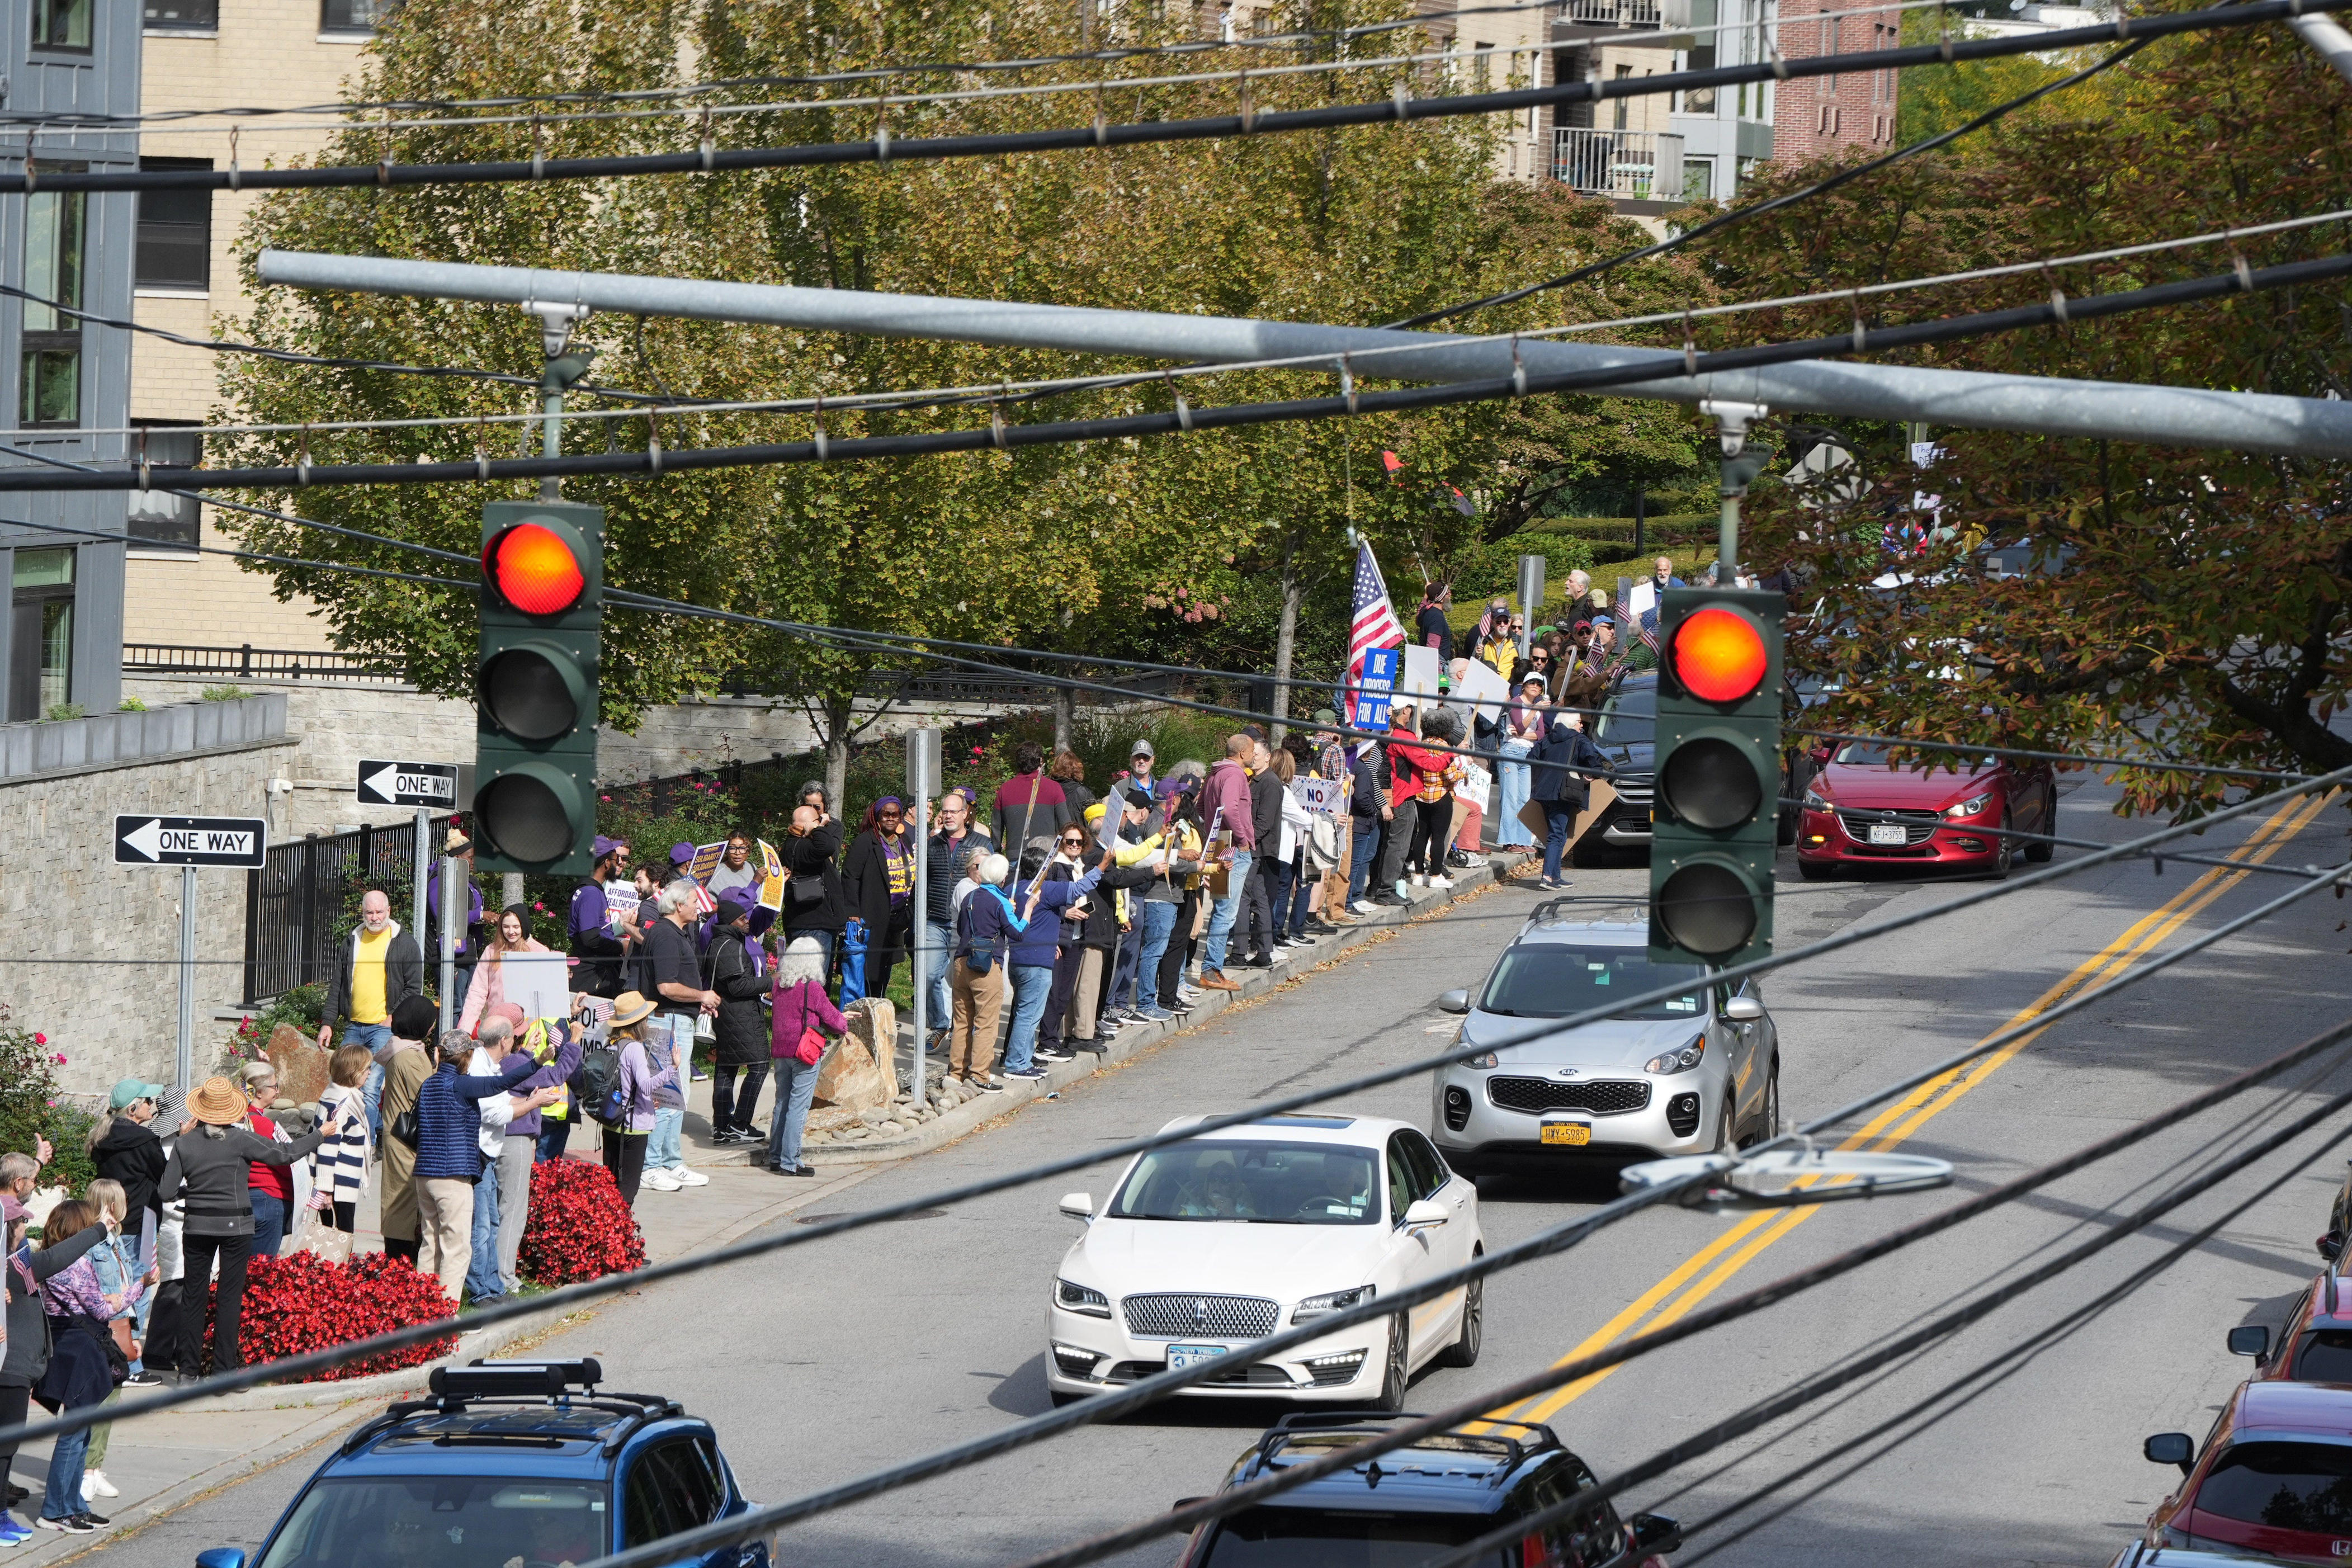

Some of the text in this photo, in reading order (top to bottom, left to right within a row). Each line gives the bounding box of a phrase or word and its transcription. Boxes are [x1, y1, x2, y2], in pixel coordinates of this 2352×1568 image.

[1373, 654, 1387, 674] DUE
[1362, 678, 1391, 699] PROCESS
[1357, 702, 1387, 724] FOR ALL
[396, 775, 451, 795] ONE WAY
[1307, 788, 1324, 803] NO
[159, 832, 249, 852] ONE WAY
[1874, 830, 1902, 839] KFJ 3755
[608, 888, 638, 900] AFFORDABL
[1566, 1129, 1585, 1141] 5985
